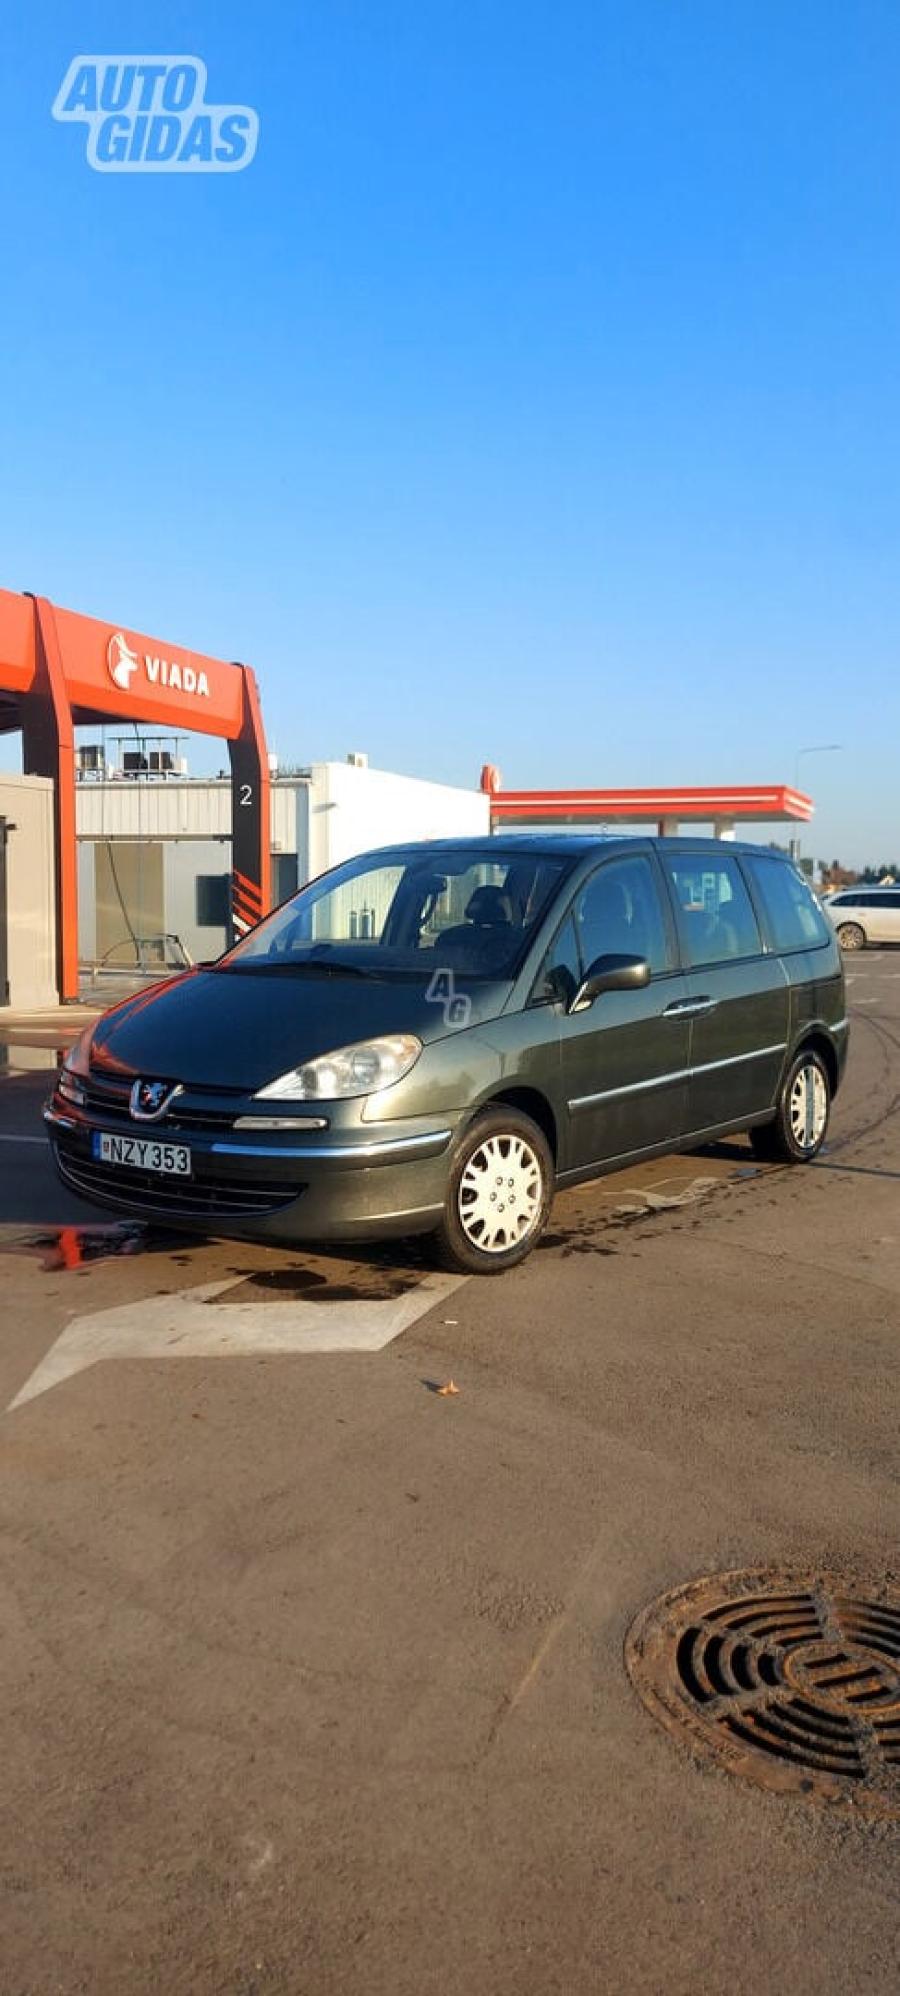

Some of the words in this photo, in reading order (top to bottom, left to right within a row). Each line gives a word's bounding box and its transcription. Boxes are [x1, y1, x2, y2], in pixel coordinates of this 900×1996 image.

[144, 655, 210, 697] VIADA
[239, 784, 253, 805] 2
[110, 1137, 148, 1166] NZY
[151, 1145, 188, 1173] 353
